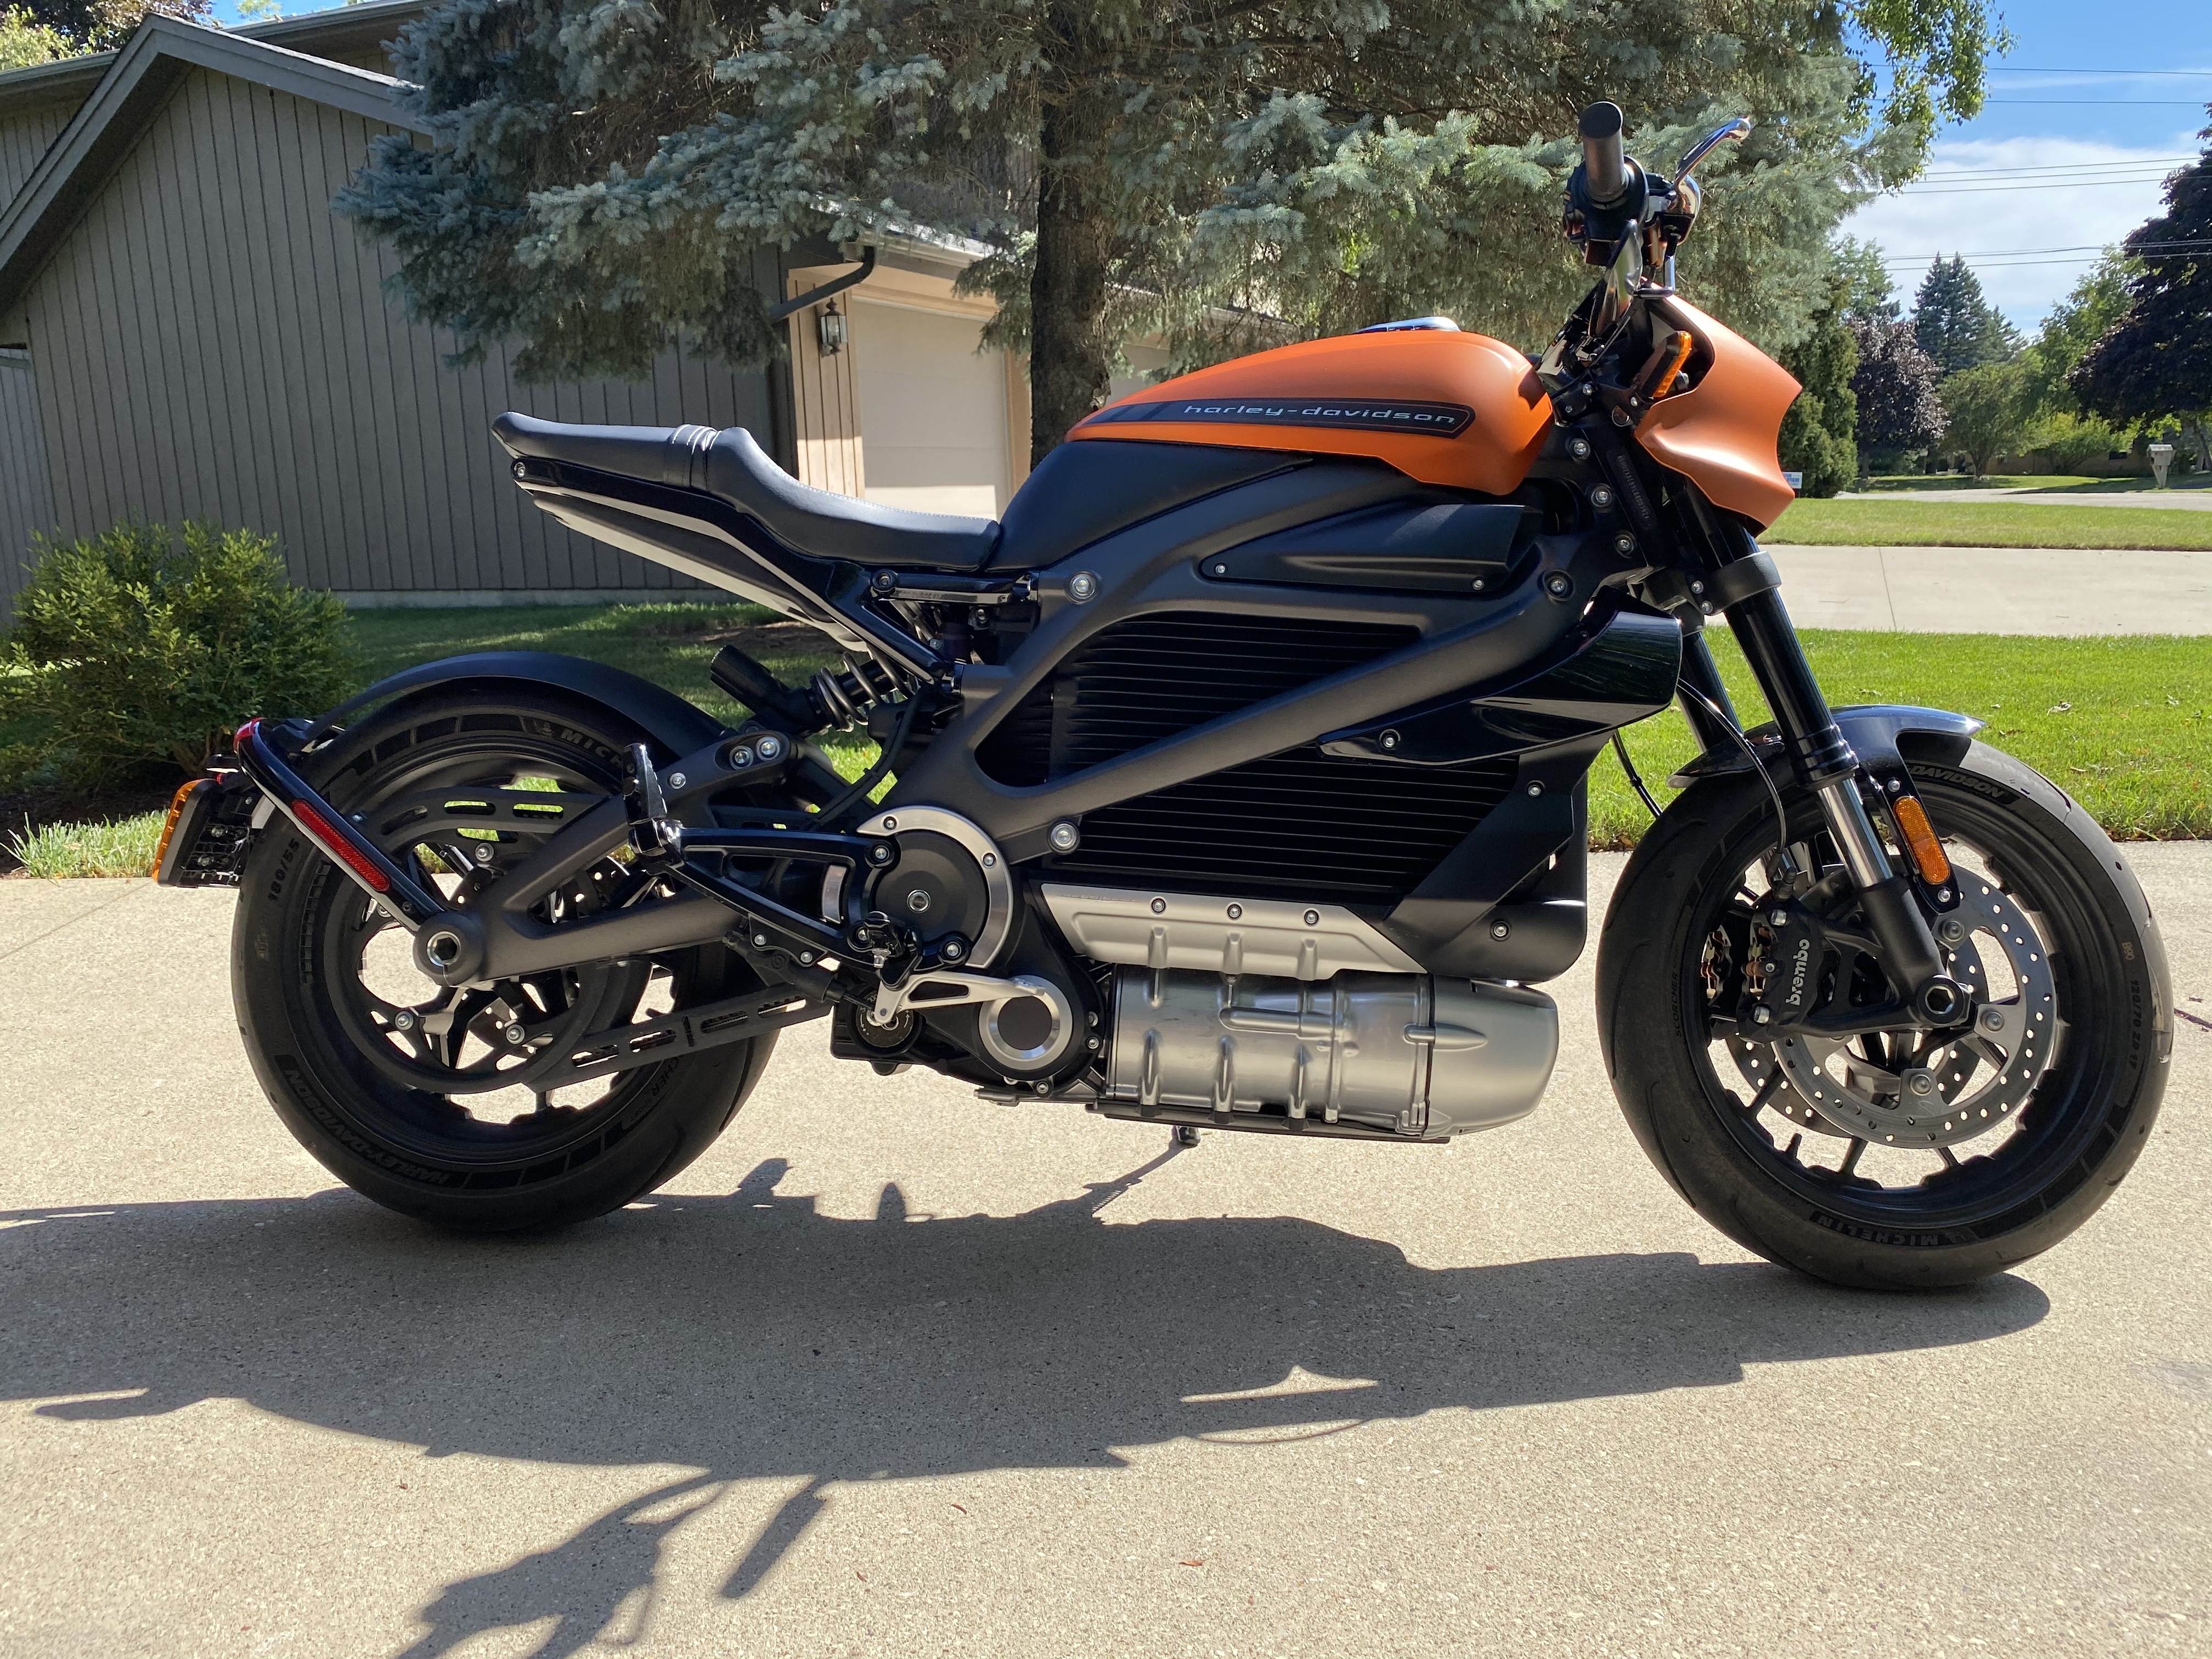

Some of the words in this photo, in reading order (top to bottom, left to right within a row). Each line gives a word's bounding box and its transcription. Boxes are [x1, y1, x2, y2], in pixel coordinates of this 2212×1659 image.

[1183, 405, 1455, 424] harley-davidson
[561, 729, 622, 768] MICH
[268, 837, 300, 902] 180/55
[2121, 941, 2136, 961] B90
[1785, 939, 1810, 1006] brembo
[1671, 971, 1681, 1037] SCORCHER
[2130, 979, 2142, 1027] 120/70
[2132, 1030, 2141, 1051] ZR
[2129, 1053, 2139, 1070] 17
[284, 1069, 450, 1184] HARLEY-DAVIDSON
[1817, 1215, 1938, 1246] MICHELIN
